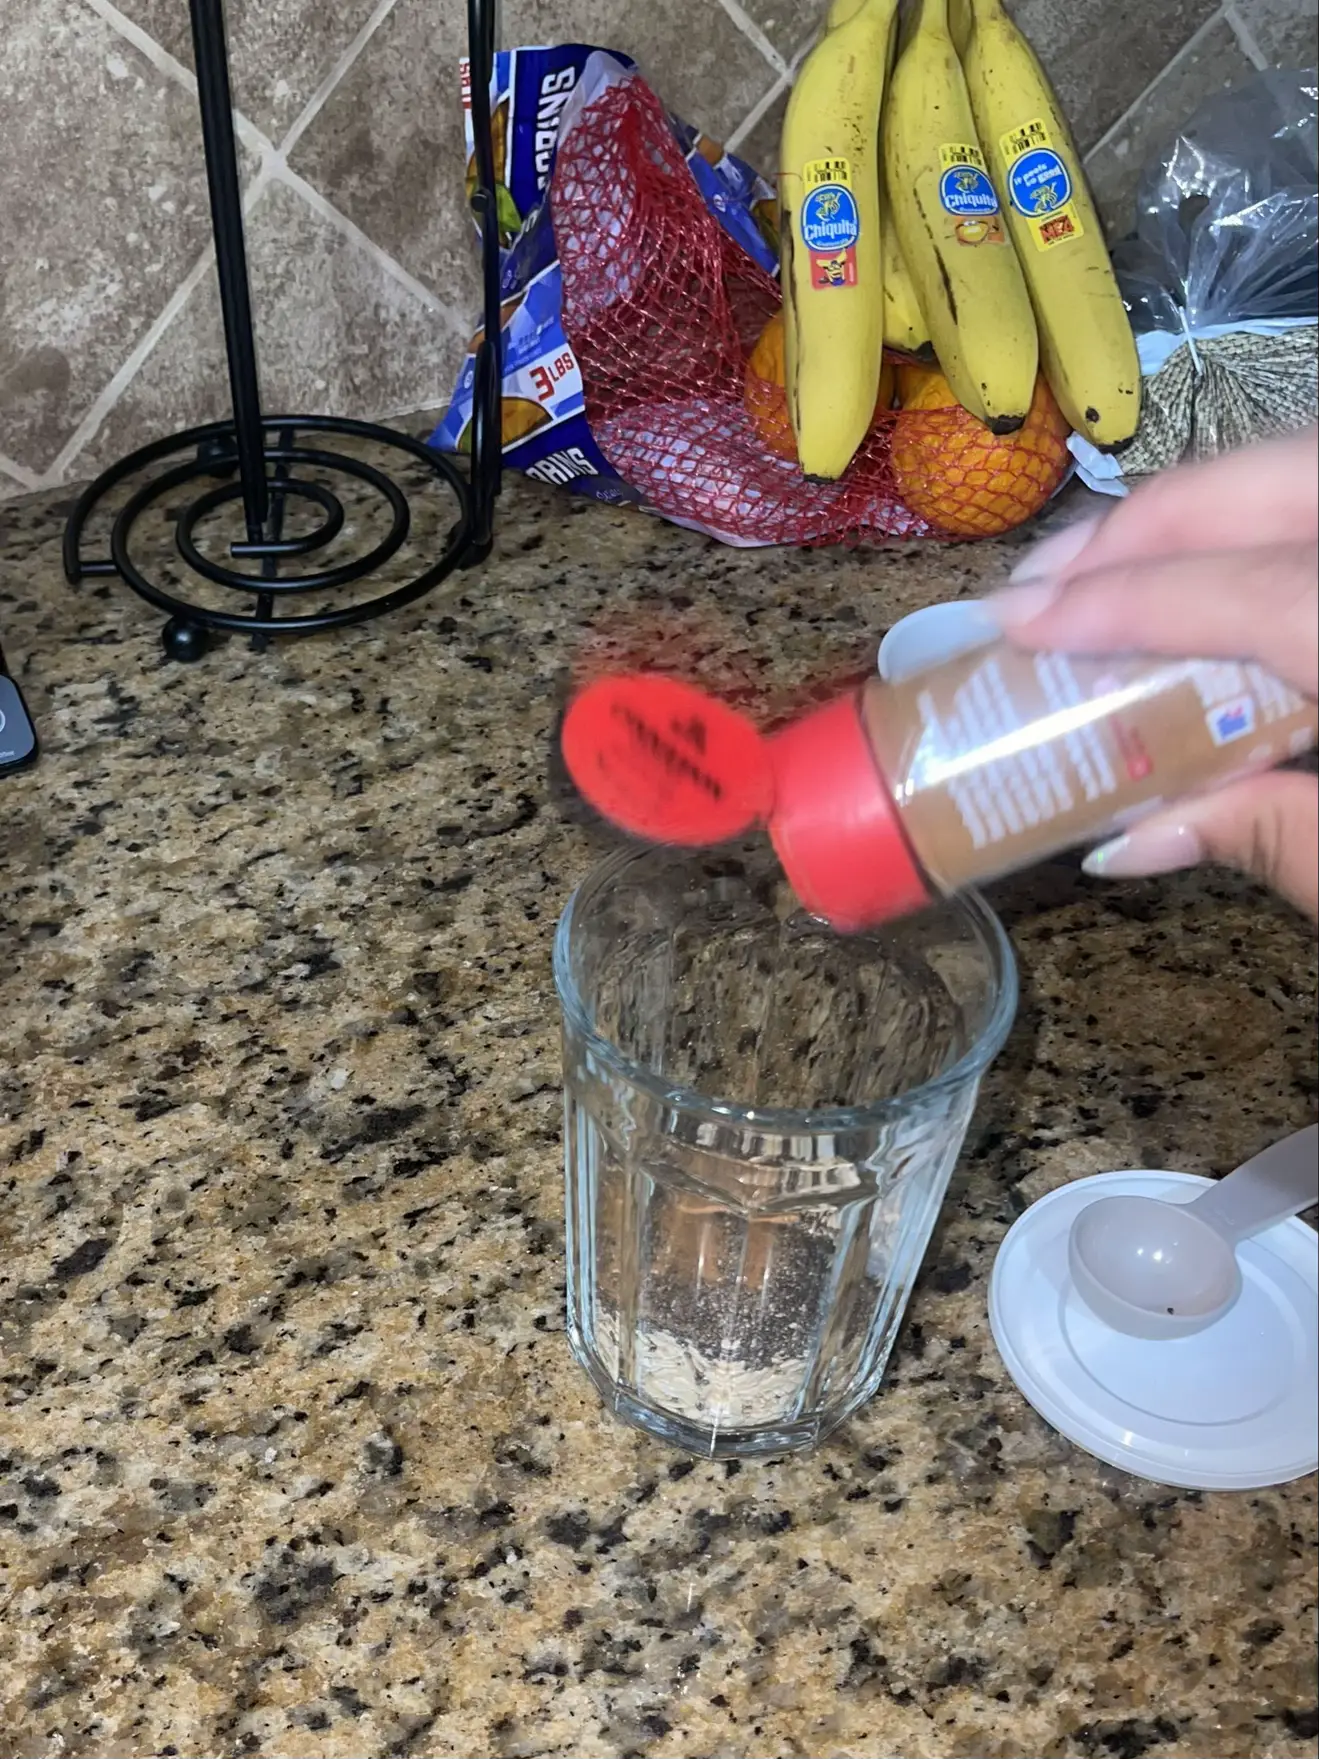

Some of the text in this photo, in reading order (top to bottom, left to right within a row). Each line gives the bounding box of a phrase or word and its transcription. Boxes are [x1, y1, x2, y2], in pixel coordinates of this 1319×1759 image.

[944, 193, 998, 208] Chiquita
[804, 219, 858, 241] Chiquita
[529, 366, 556, 401] 3
[547, 353, 574, 382] LBS
